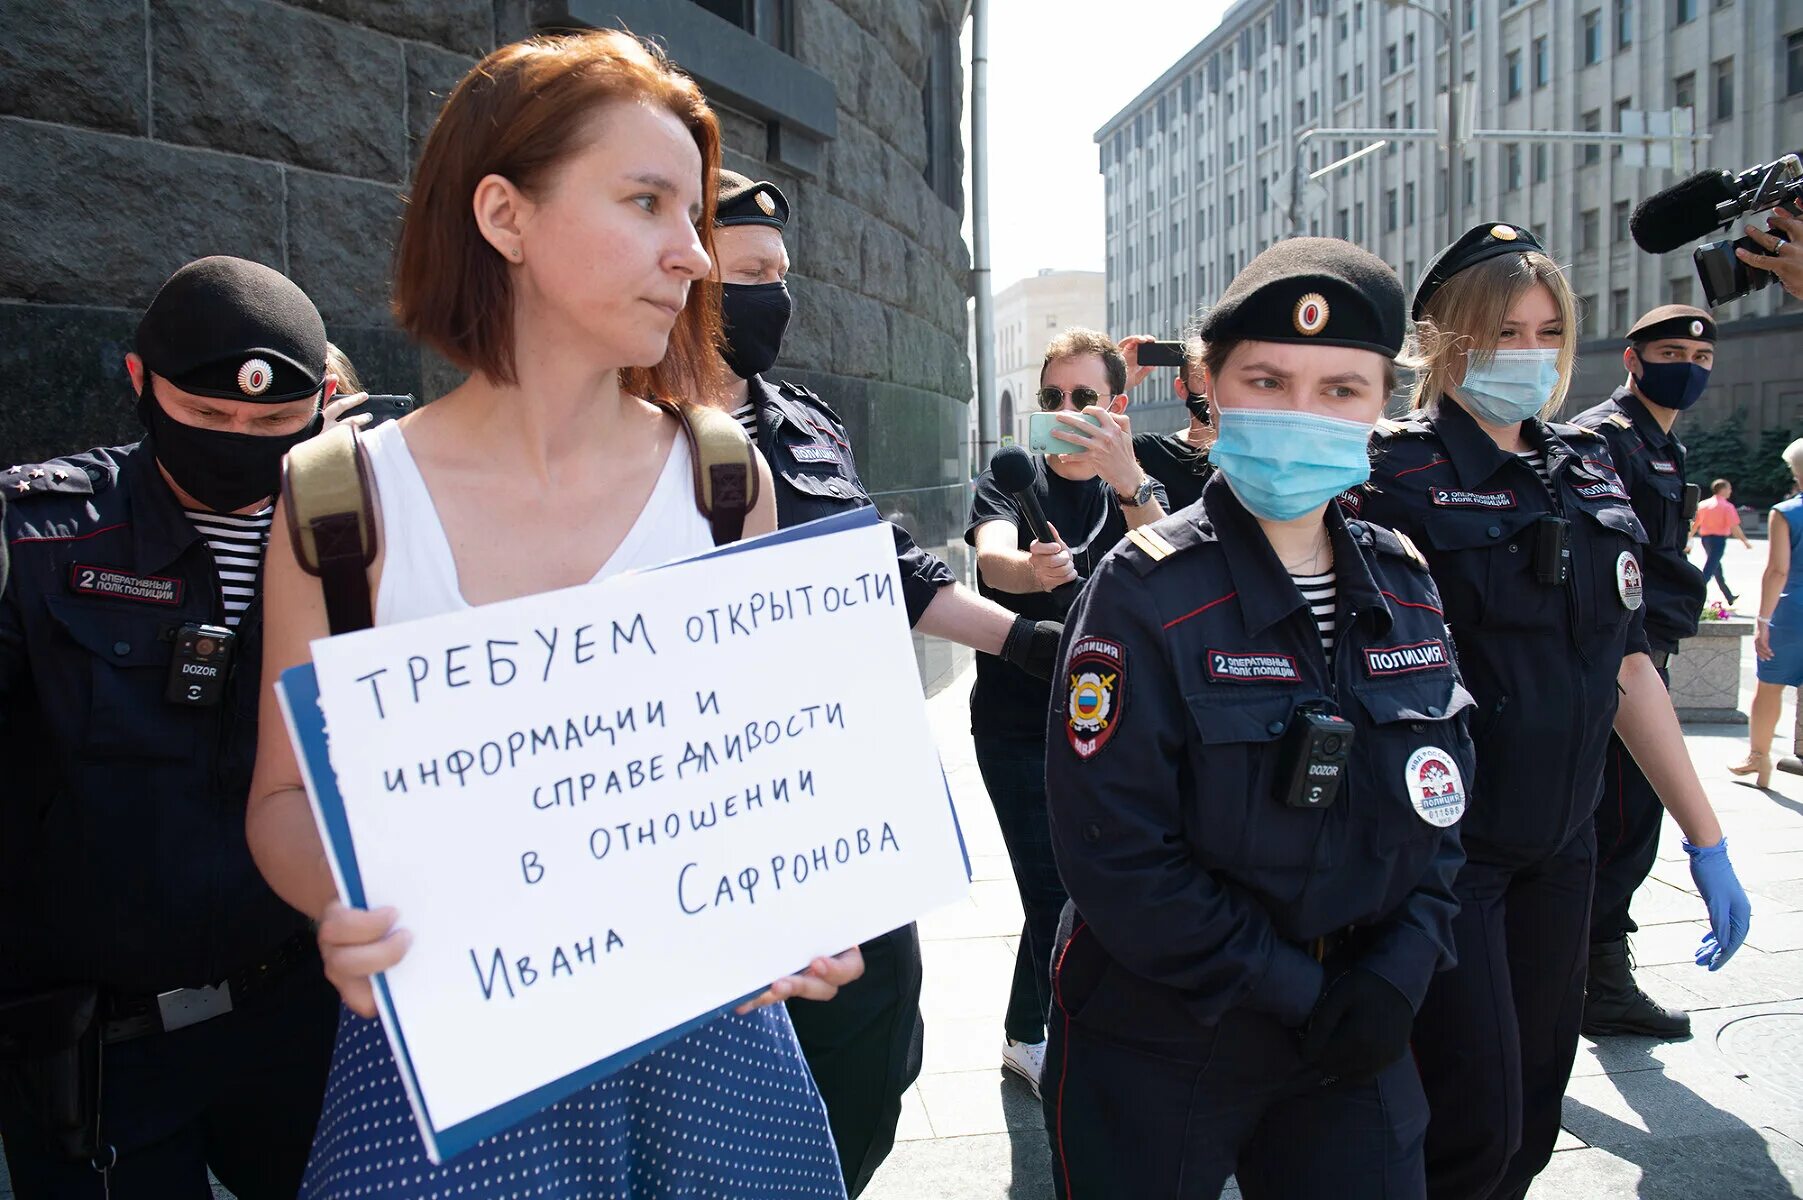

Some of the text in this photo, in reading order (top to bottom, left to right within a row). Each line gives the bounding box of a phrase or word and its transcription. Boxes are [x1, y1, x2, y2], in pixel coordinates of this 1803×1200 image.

[1438, 491, 1450, 502] 2
[1577, 483, 1625, 496] ПОЛИ
[79, 570, 173, 591] 2 ОПЕРАТИВНЫЙ
[96, 581, 174, 600] ПОЛК ПОЛИЦИИ
[355, 573, 896, 719] ТРЕБУЕМ ОТКРЫТОСТИ
[1072, 641, 1119, 659] ПОЛИЦИЯ
[1214, 655, 1291, 674] 2 ОПЕРАТИВНЫЙ
[1369, 646, 1444, 670] ПОЛИЦИЯ
[182, 663, 218, 677] DOZOR
[1227, 665, 1296, 678] ПОЛК ПОЛИЦИИ
[384, 691, 720, 795] ИНФОРМАЦИИ И
[1075, 738, 1096, 756] МВД
[531, 702, 846, 812] СПРАВЕДЛИВОСТИ
[1309, 764, 1339, 776] DOZOR
[1423, 794, 1461, 808] ПОЛИЦИЯ
[521, 769, 816, 884] В ОТНОШЕНИИ
